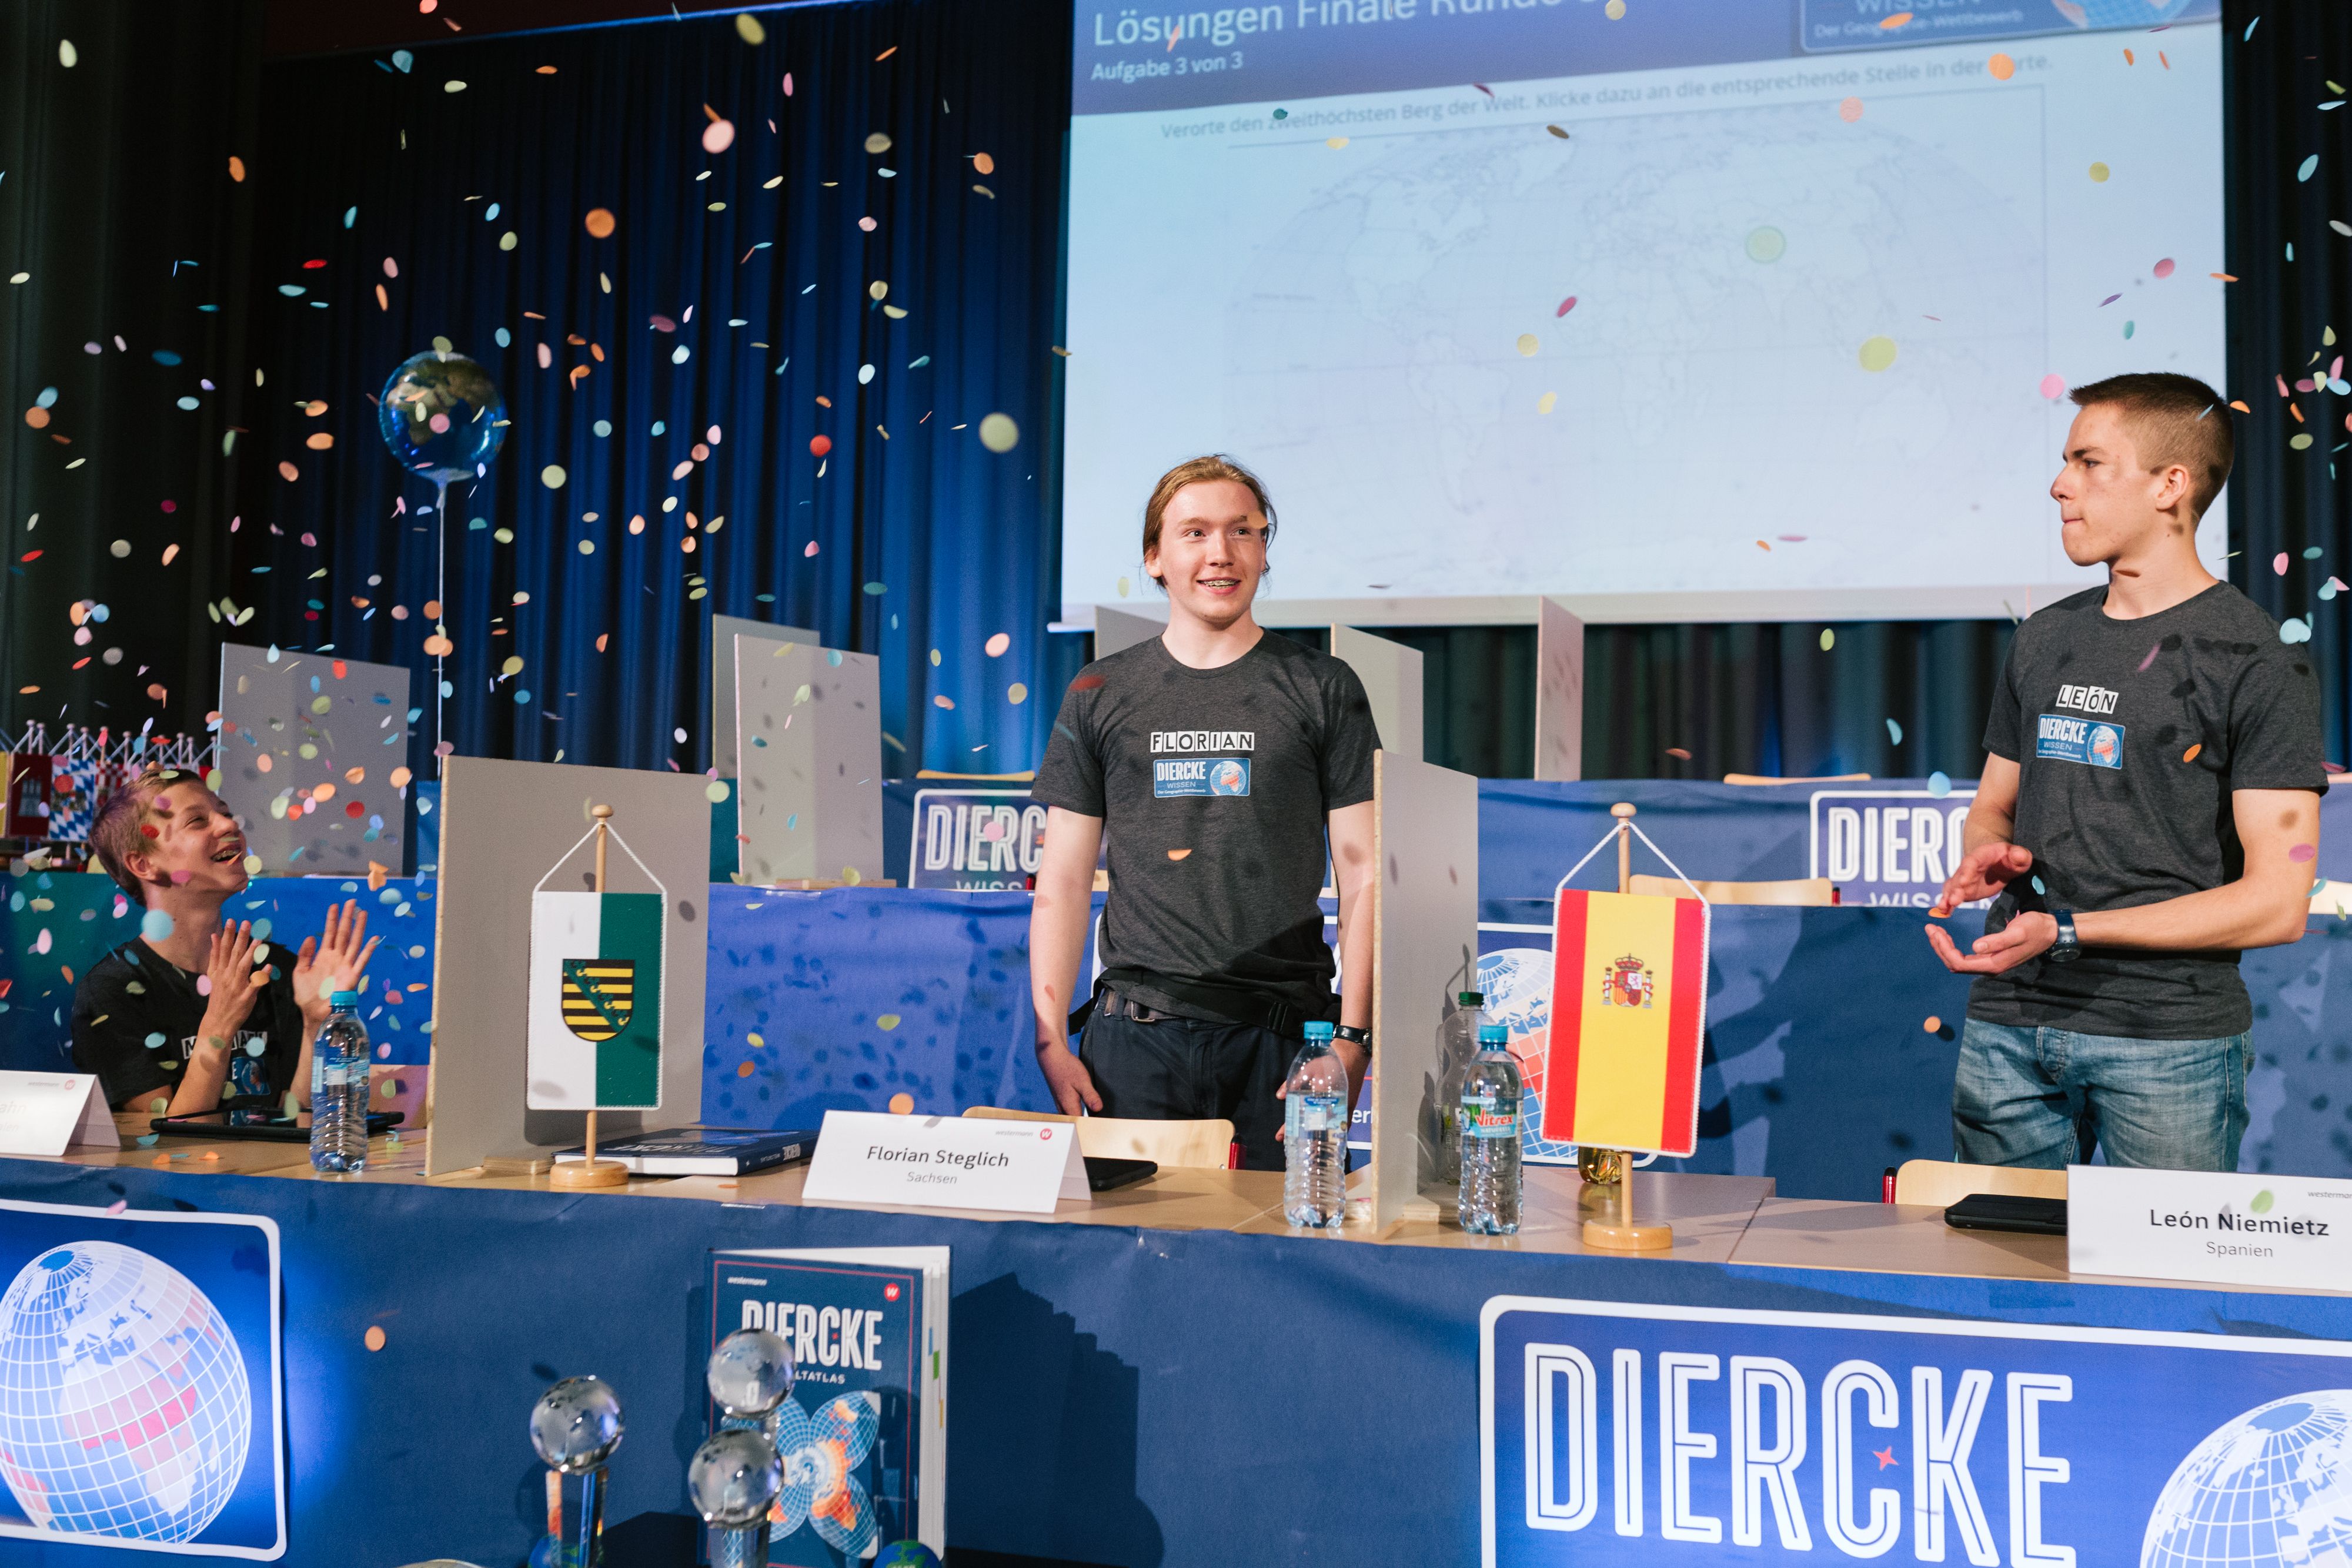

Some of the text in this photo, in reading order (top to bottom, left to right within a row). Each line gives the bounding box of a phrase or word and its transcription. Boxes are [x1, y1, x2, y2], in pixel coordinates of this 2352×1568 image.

[1094, 5, 1283, 46] Lösungen
[1297, 0, 1416, 28] Finale
[1091, 51, 1244, 83] Aufgabe 3 von 3
[1161, 121, 1225, 138] Verorte
[1230, 116, 1263, 133] den
[1402, 102, 1442, 121] Berg
[1448, 99, 1476, 116] der
[1536, 90, 1589, 109] Klicke
[1596, 86, 1642, 103] dazu
[1646, 85, 1671, 100] an
[1676, 81, 1705, 98] die
[1710, 69, 1859, 95] entsprechende
[1865, 63, 1920, 83] Stelle
[1926, 60, 1945, 78] in
[1950, 58, 1983, 75] der
[2058, 687, 2116, 711] LEÓN
[1152, 733, 1252, 751] FLORIAN
[2039, 717, 2088, 744] DIERCKE
[2043, 741, 2073, 751] WISSEN
[1157, 761, 1206, 781] DIERCKE
[924, 805, 1047, 873] DIERC
[1828, 806, 1971, 883] DIERC
[1475, 1109, 1514, 1126] Vitrex
[867, 1146, 1009, 1169] Florian Steglich
[907, 1171, 958, 1185] Sachsen
[2150, 1209, 2330, 1236] León Niemietz
[2206, 1241, 2273, 1258] Spanien
[796, 1370, 846, 1385] LTATLAS
[1525, 1342, 2076, 1568] DIERCKE
